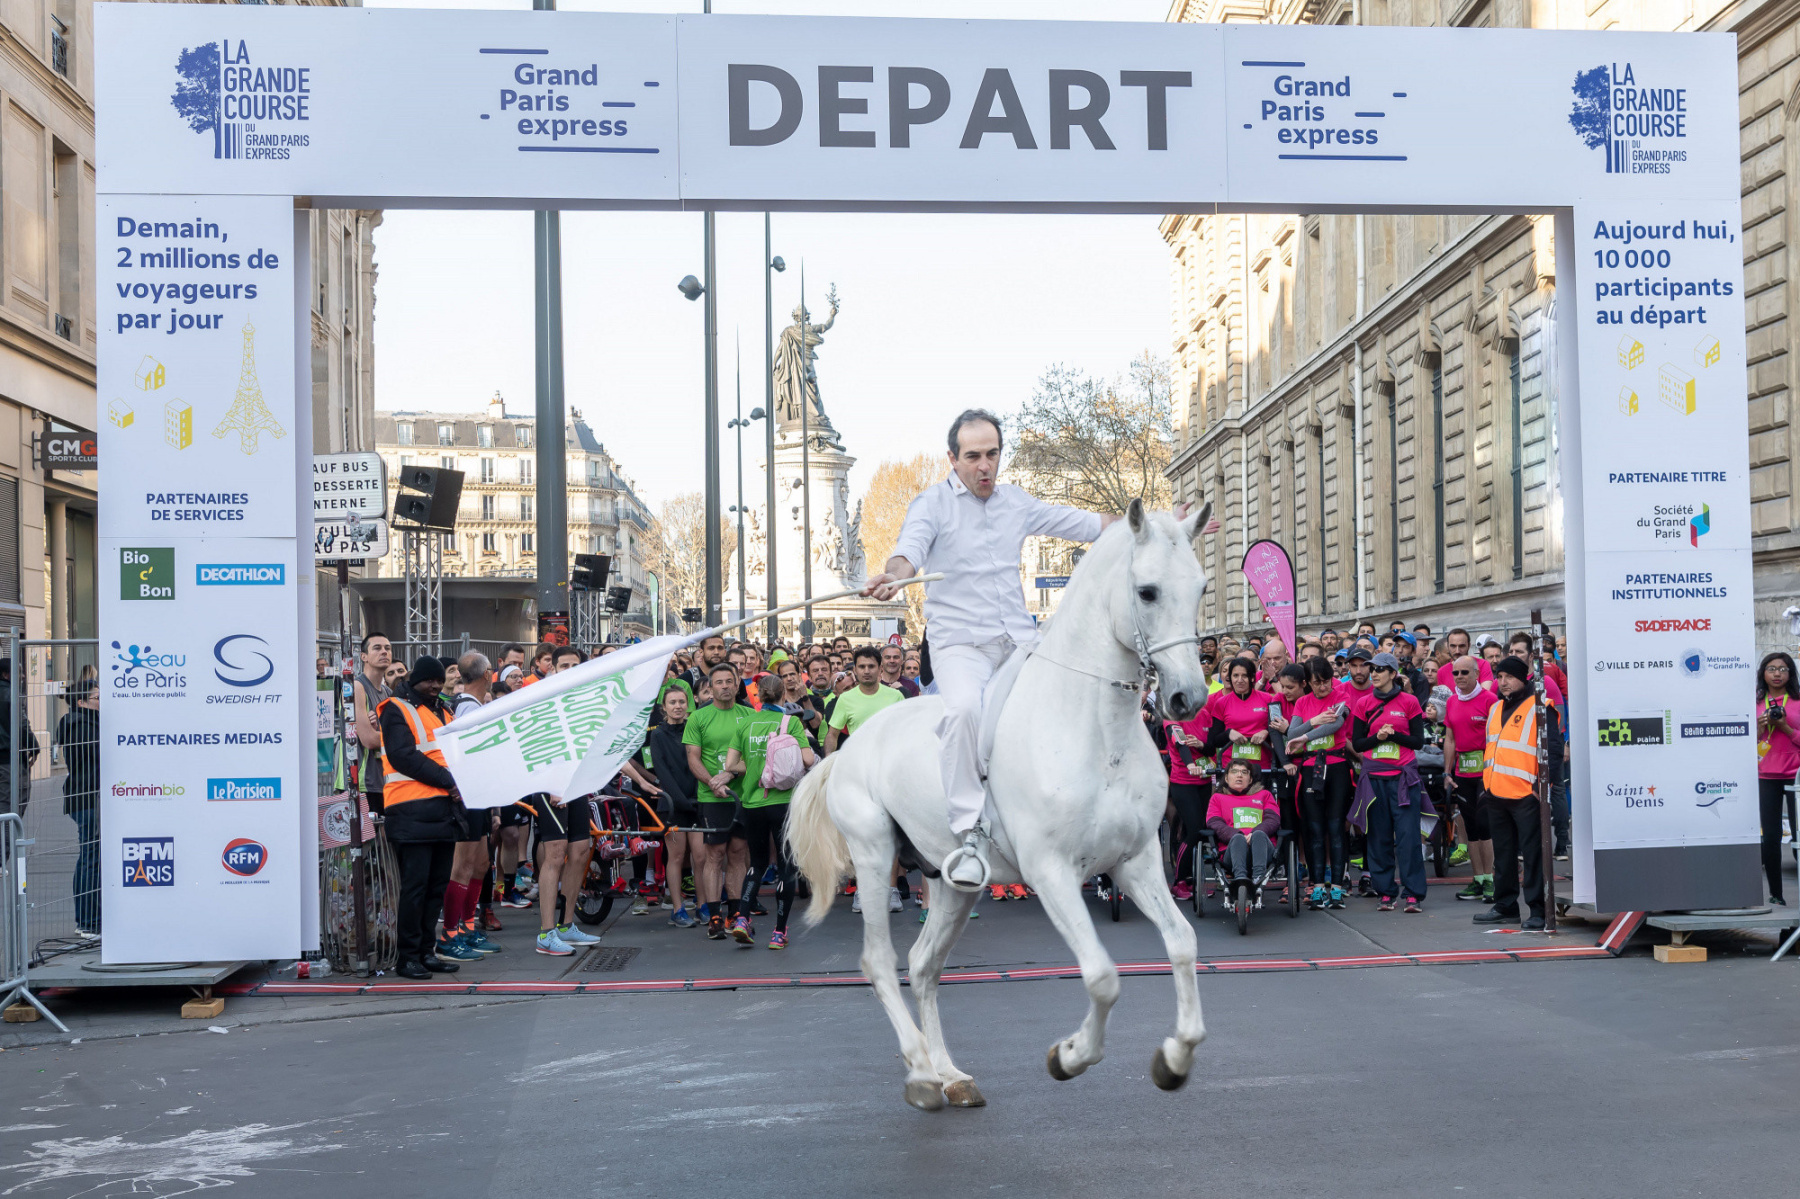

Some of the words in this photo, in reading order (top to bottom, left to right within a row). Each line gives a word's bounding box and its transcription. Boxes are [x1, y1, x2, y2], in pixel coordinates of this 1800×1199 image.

[223, 39, 250, 65] LA
[224, 67, 310, 93] GRANDE
[514, 62, 598, 87] Grand
[1613, 63, 1635, 85] LA
[1273, 74, 1351, 97] Grand
[500, 88, 569, 111] Paris
[1613, 88, 1686, 112] GRANDE
[224, 94, 310, 121] COURSE
[727, 63, 1192, 151] DEPART
[1261, 100, 1325, 122] Paris
[245, 123, 255, 132] DU
[517, 114, 628, 140] express
[1614, 114, 1686, 137] COURSE
[245, 134, 279, 146] GRAND
[280, 135, 310, 147] PARIS
[1277, 124, 1378, 148] express
[1632, 140, 1640, 148] DU
[245, 147, 290, 160] EXPRESS
[1632, 151, 1661, 161] GRAND
[1663, 151, 1687, 161] PARIS
[1632, 163, 1670, 174] EXPRESS
[117, 217, 228, 243] Demain,
[1594, 220, 1686, 244] Aujourd
[1694, 220, 1734, 243] hui,
[117, 247, 132, 268] 2
[140, 247, 241, 269] millions
[247, 248, 279, 269] de
[1594, 250, 1619, 268] 10
[1625, 250, 1671, 268] 000
[117, 281, 257, 304] voyageurs
[1596, 277, 1733, 301] participants
[117, 312, 161, 334] par
[167, 308, 224, 334] jour
[1596, 309, 1623, 324] au
[1630, 304, 1707, 329] départ
[48, 440, 97, 456] CMG
[313, 463, 336, 473] AUF
[343, 462, 368, 472] BUS
[1609, 472, 1688, 483] PARTENAIRE
[1691, 472, 1726, 481] TITRE
[314, 480, 378, 491] DESSERTE
[146, 493, 248, 504] PARTENAIRES
[314, 498, 366, 509] NTERNE
[151, 509, 170, 520] DE
[175, 509, 244, 521] SERVICES
[1654, 505, 1693, 515] Société
[1637, 518, 1650, 527] du
[1654, 517, 1686, 527] Grand
[1656, 529, 1681, 538] Paris
[341, 541, 371, 553] PAS
[123, 551, 149, 564] Bio
[201, 568, 280, 581] DECATHLON
[1626, 573, 1712, 584] PARTENAIRES
[140, 584, 171, 597] Bon
[1613, 587, 1726, 599] INSTITUTIONNELS
[146, 654, 185, 667] eau
[1634, 661, 1644, 669] DE
[114, 673, 139, 688] de
[146, 673, 186, 688] Paris
[206, 695, 261, 704] SWEDISH
[264, 695, 282, 703] FIT
[118, 734, 220, 745] PARTENAIRES
[225, 733, 282, 744] MEDIAS
[214, 786, 225, 799] Le
[227, 781, 274, 799] Parisien
[1606, 784, 1643, 796] Saint
[1625, 797, 1664, 808] Denis
[123, 842, 173, 861] BFM
[229, 852, 259, 864] RFM
[125, 860, 172, 885] PARIS
